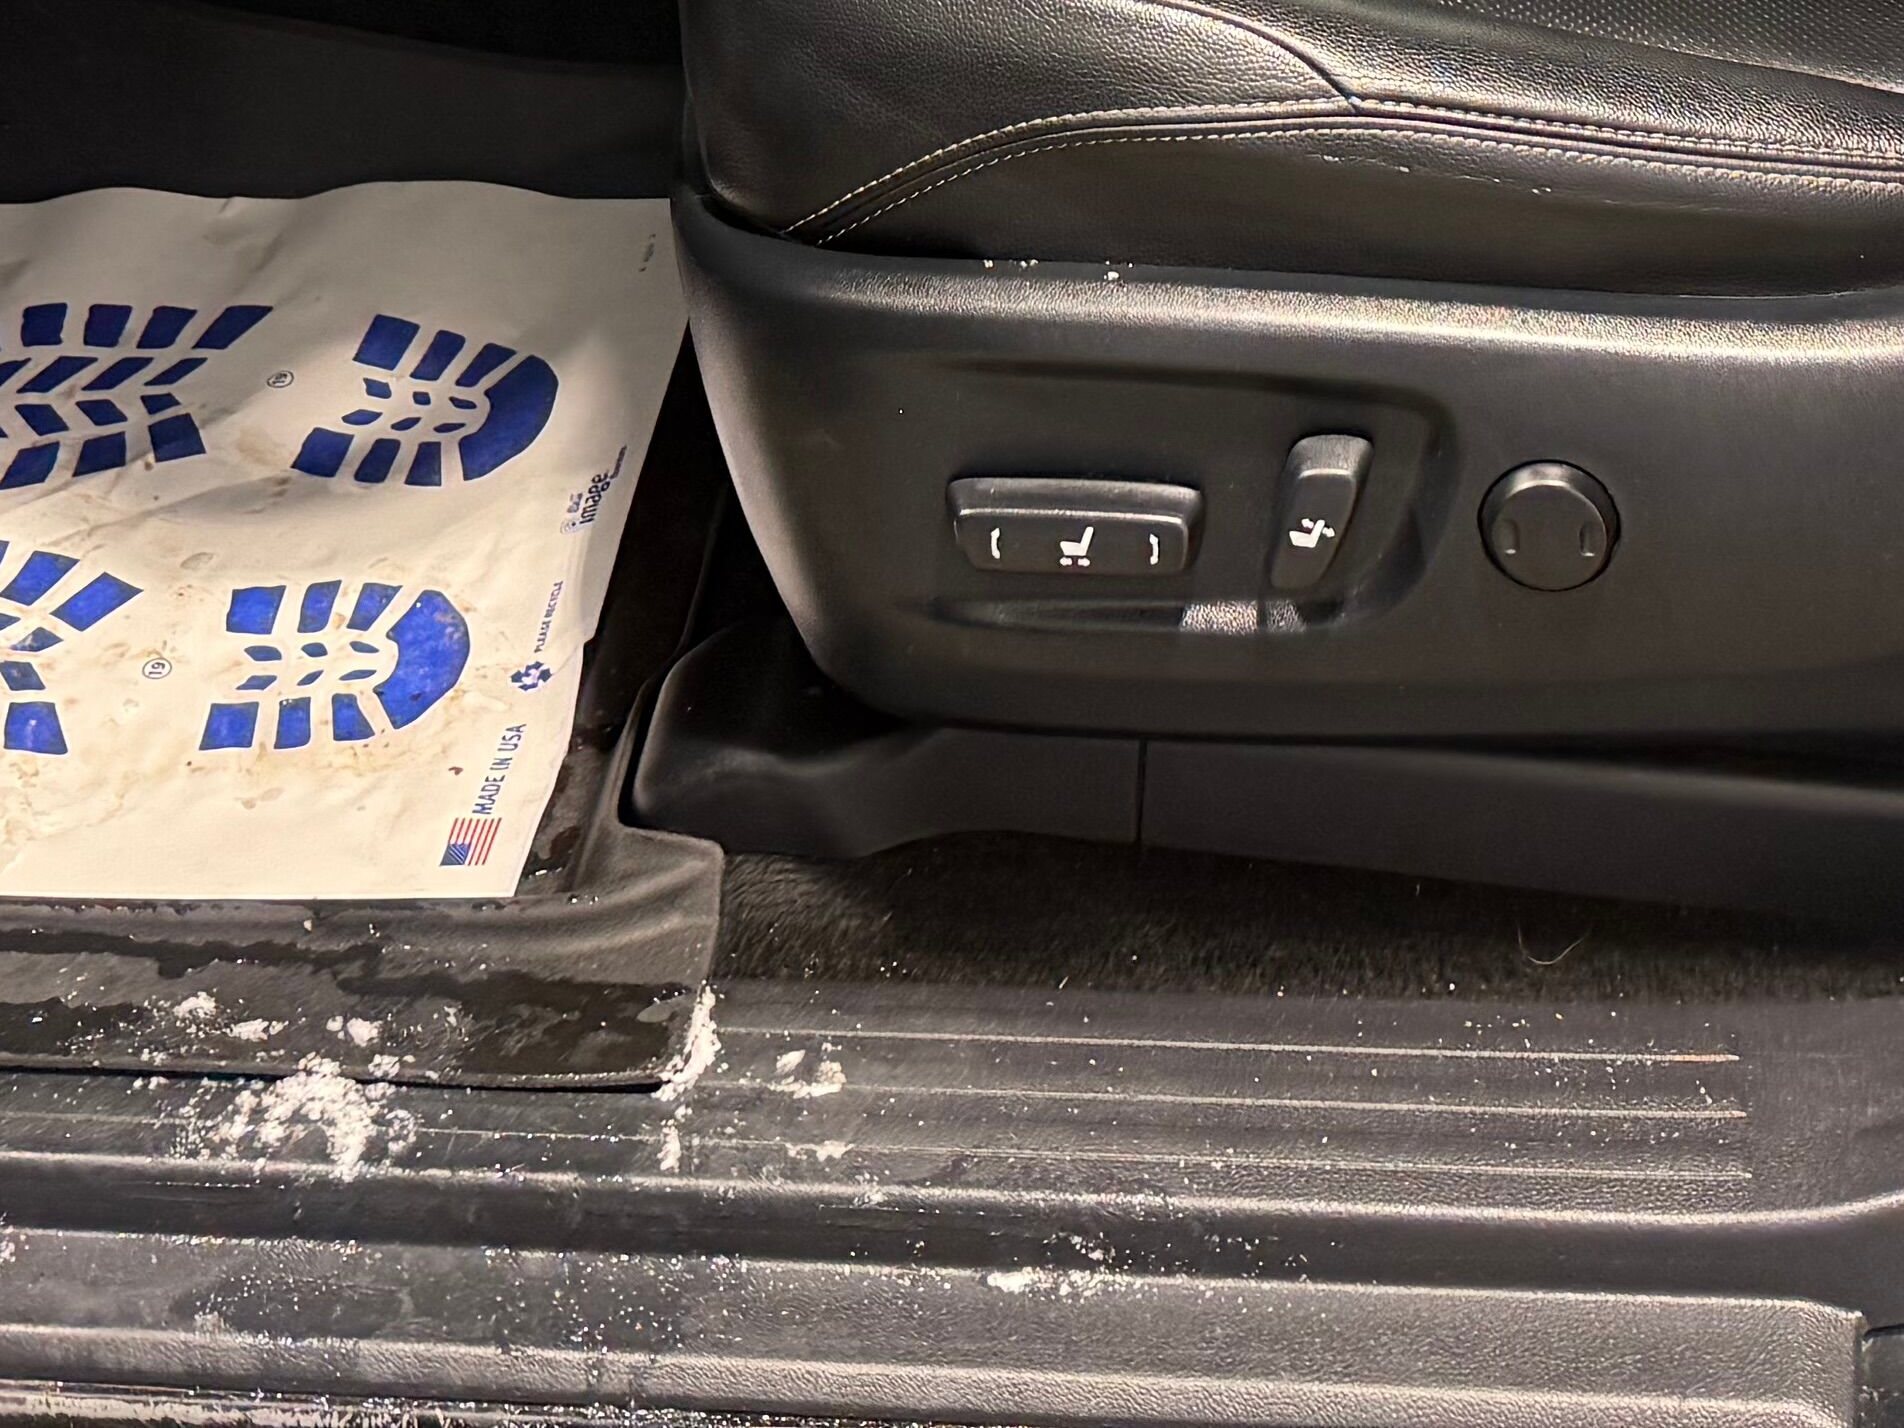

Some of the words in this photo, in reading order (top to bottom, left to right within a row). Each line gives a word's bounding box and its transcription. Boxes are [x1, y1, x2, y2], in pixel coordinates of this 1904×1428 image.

[534, 620, 551, 654] PLEASE
[500, 722, 528, 751] USA
[490, 750, 514, 771] IN
[471, 774, 506, 816] MADE
